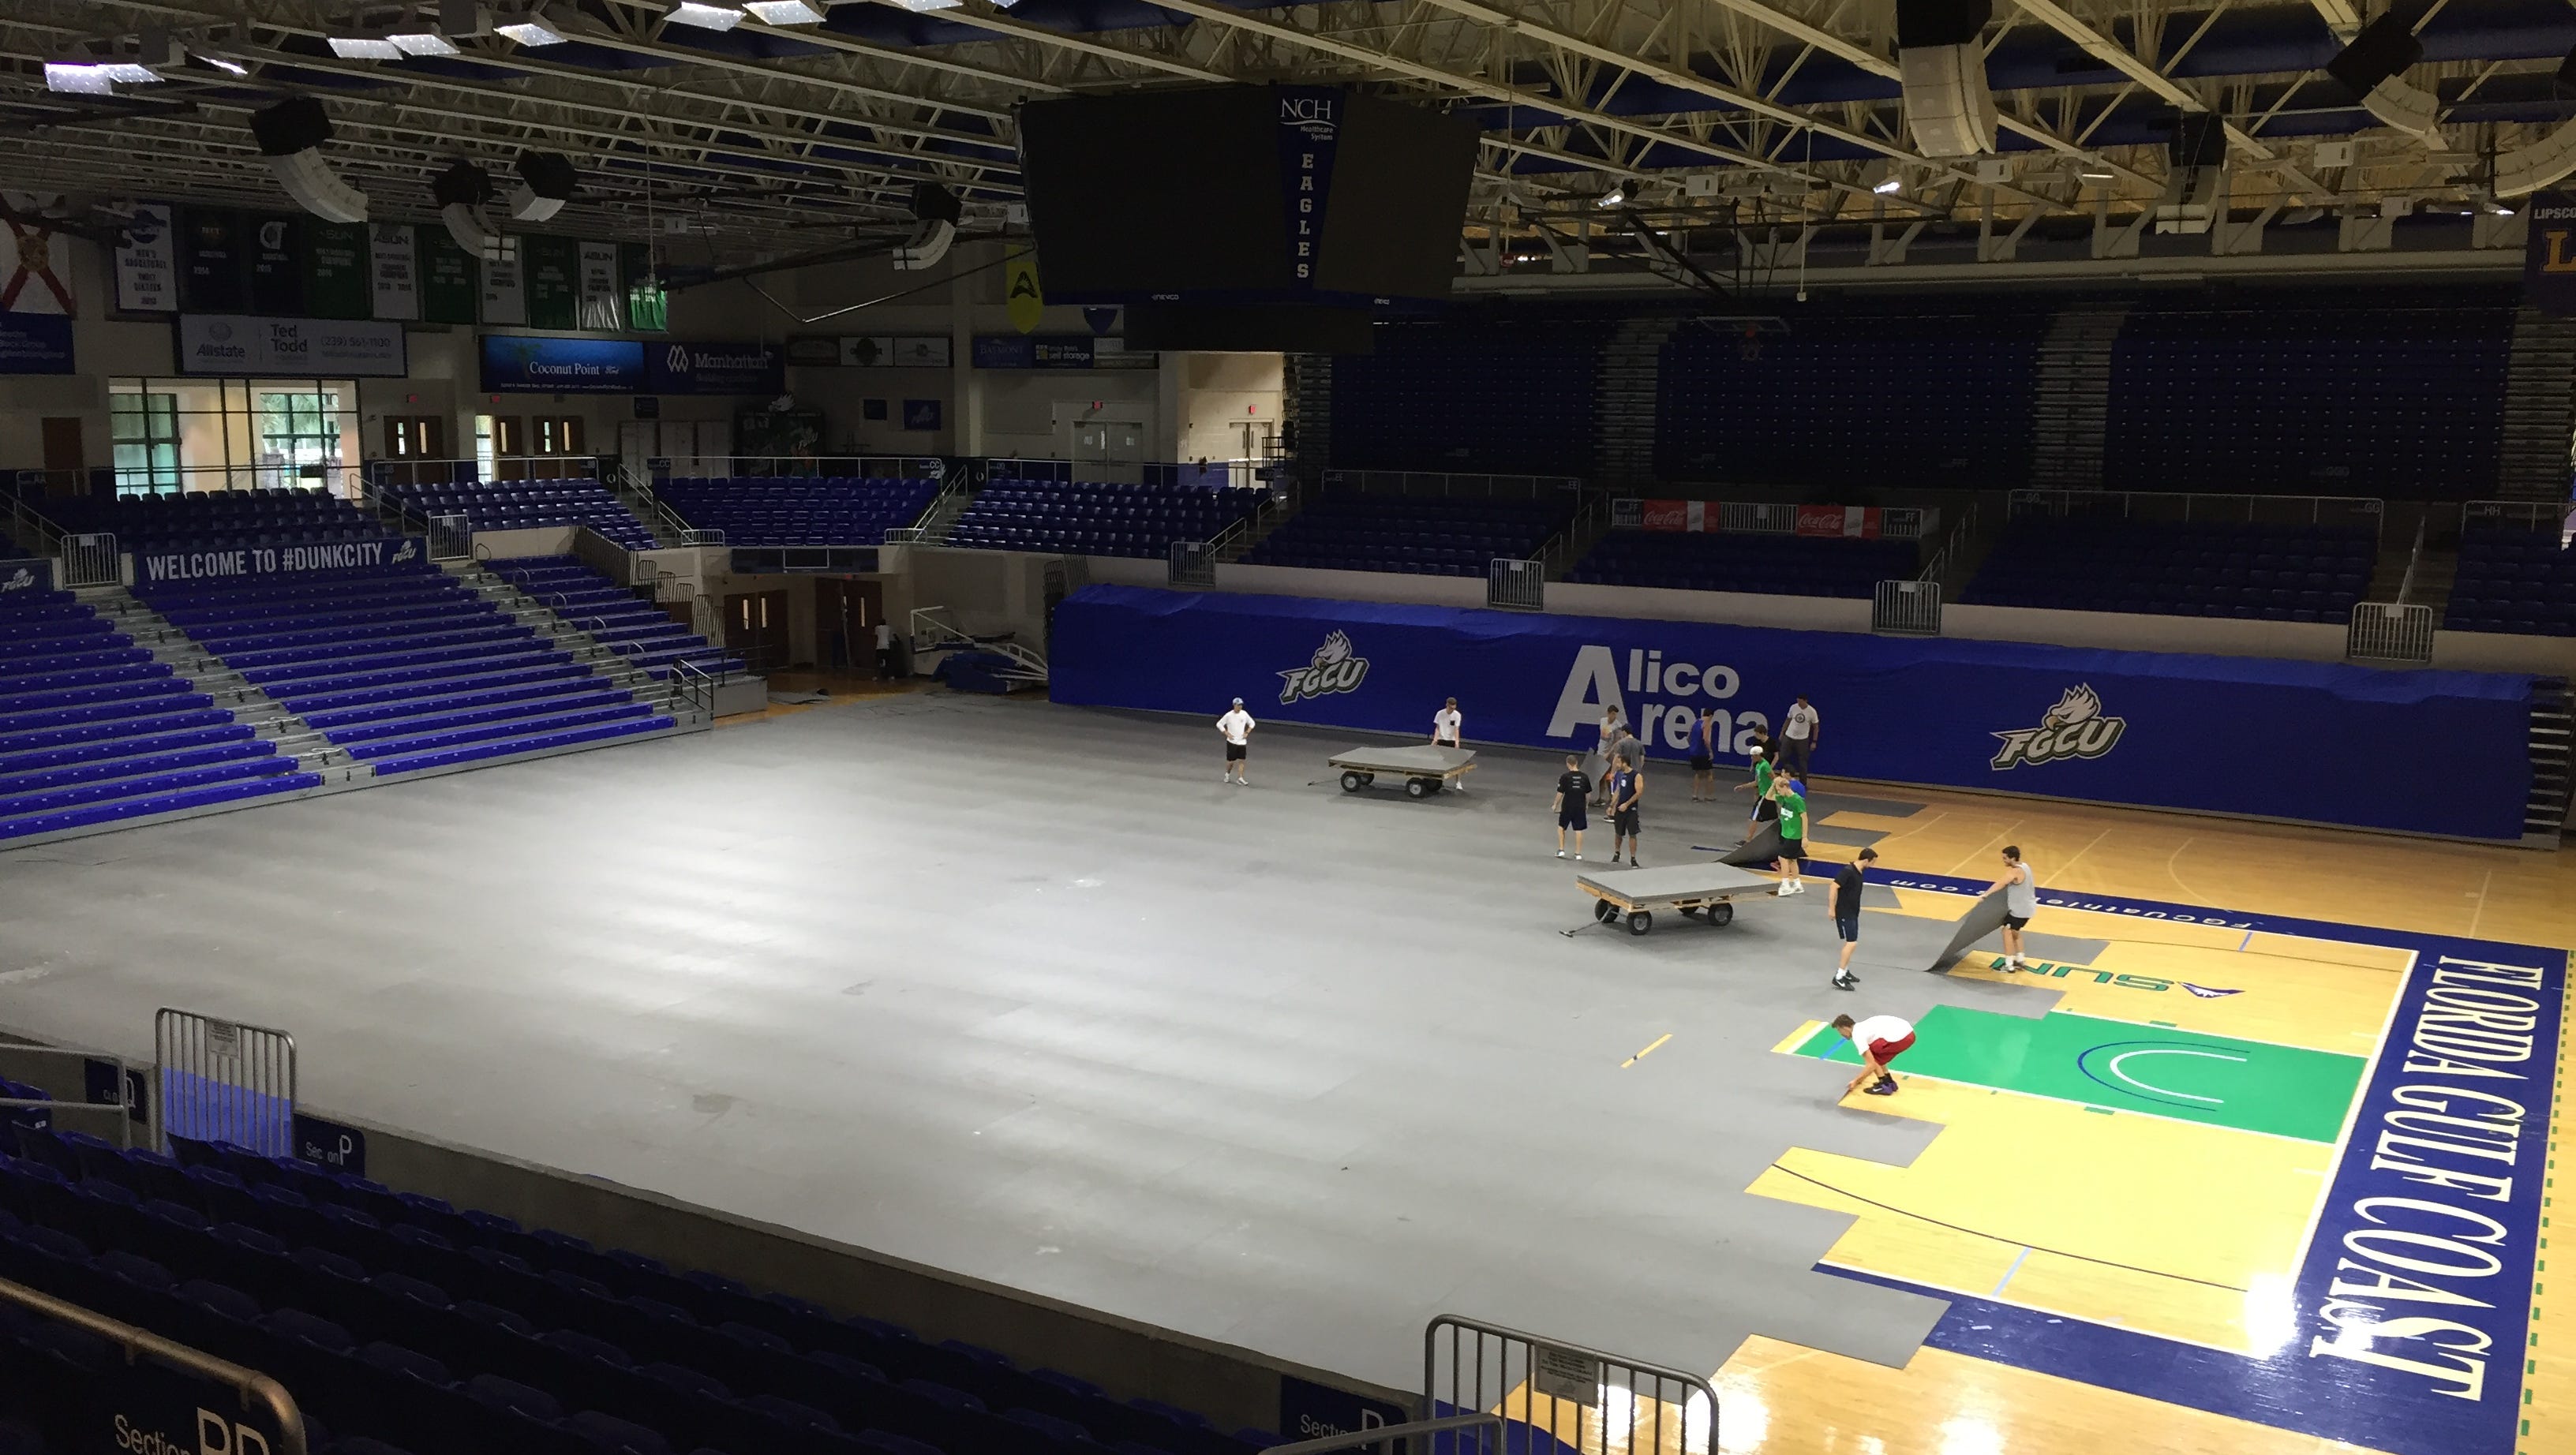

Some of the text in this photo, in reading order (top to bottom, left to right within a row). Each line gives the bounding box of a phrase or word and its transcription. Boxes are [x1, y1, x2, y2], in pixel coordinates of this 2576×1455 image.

[1280, 98, 1331, 119] NCH
[1301, 125, 1334, 133] Healthcare
[1311, 133, 1333, 141] System
[1296, 153, 1314, 279] EAGLES
[271, 324, 297, 338] Ted
[271, 339, 308, 352] Todd
[197, 344, 245, 357] Allstate
[530, 361, 571, 374] Coconut
[575, 363, 599, 375] Point
[146, 542, 383, 581] WELCOME TO #DUNKCITY
[1276, 656, 1369, 705] FGCU
[1990, 716, 2127, 771] FGCU
[2403, 956, 2544, 1079] FLORIDA
[339, 1134, 352, 1165] P
[2370, 1085, 2526, 1203] GULF
[2309, 1196, 2509, 1402] COAST
